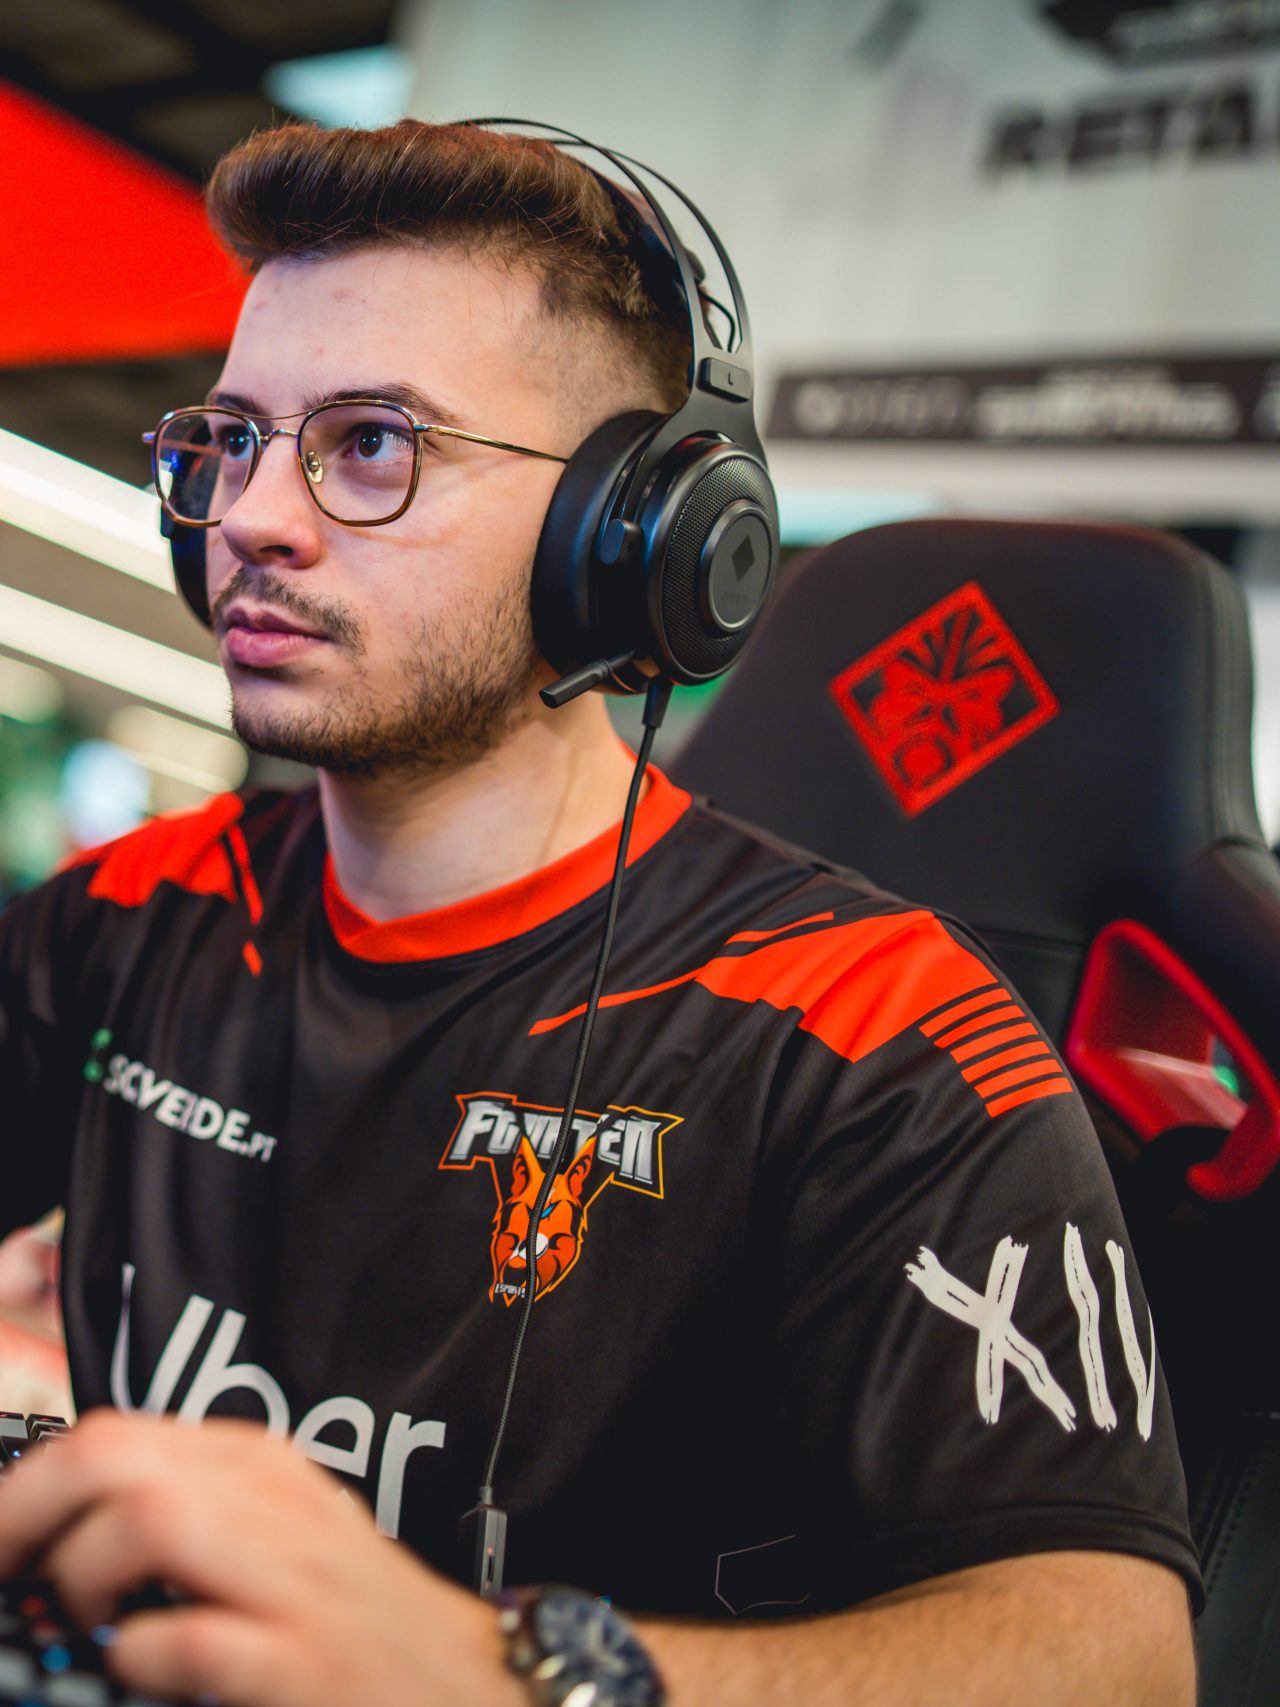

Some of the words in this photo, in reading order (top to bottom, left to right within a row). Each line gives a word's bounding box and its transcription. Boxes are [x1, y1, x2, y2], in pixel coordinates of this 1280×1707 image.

[980, 80, 1280, 185] RETA
[110, 1262, 446, 1539] Uber
[903, 1221, 1156, 1442] XIV
